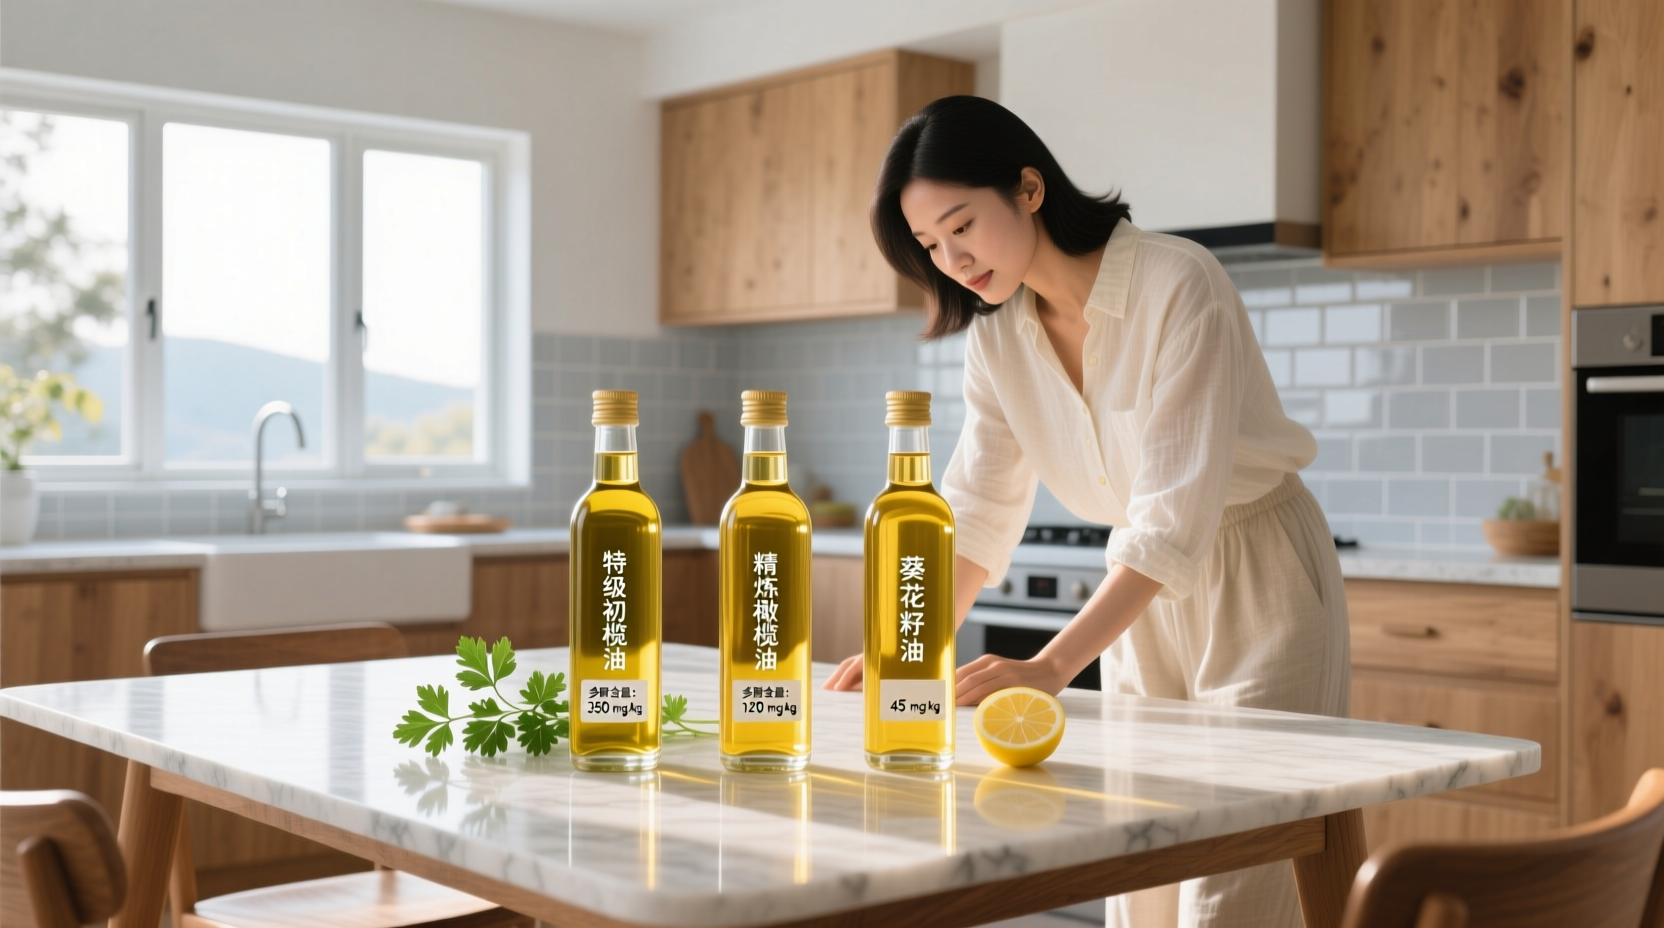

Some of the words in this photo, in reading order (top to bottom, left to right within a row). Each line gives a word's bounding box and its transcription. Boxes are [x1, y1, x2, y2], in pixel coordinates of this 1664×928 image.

[602, 549, 628, 671] 特级初榄油
[752, 551, 779, 671] 精炼橄榄油
[899, 555, 926, 662] 葵花籽油
[742, 701, 764, 713] 120
[890, 699, 906, 712] 45
